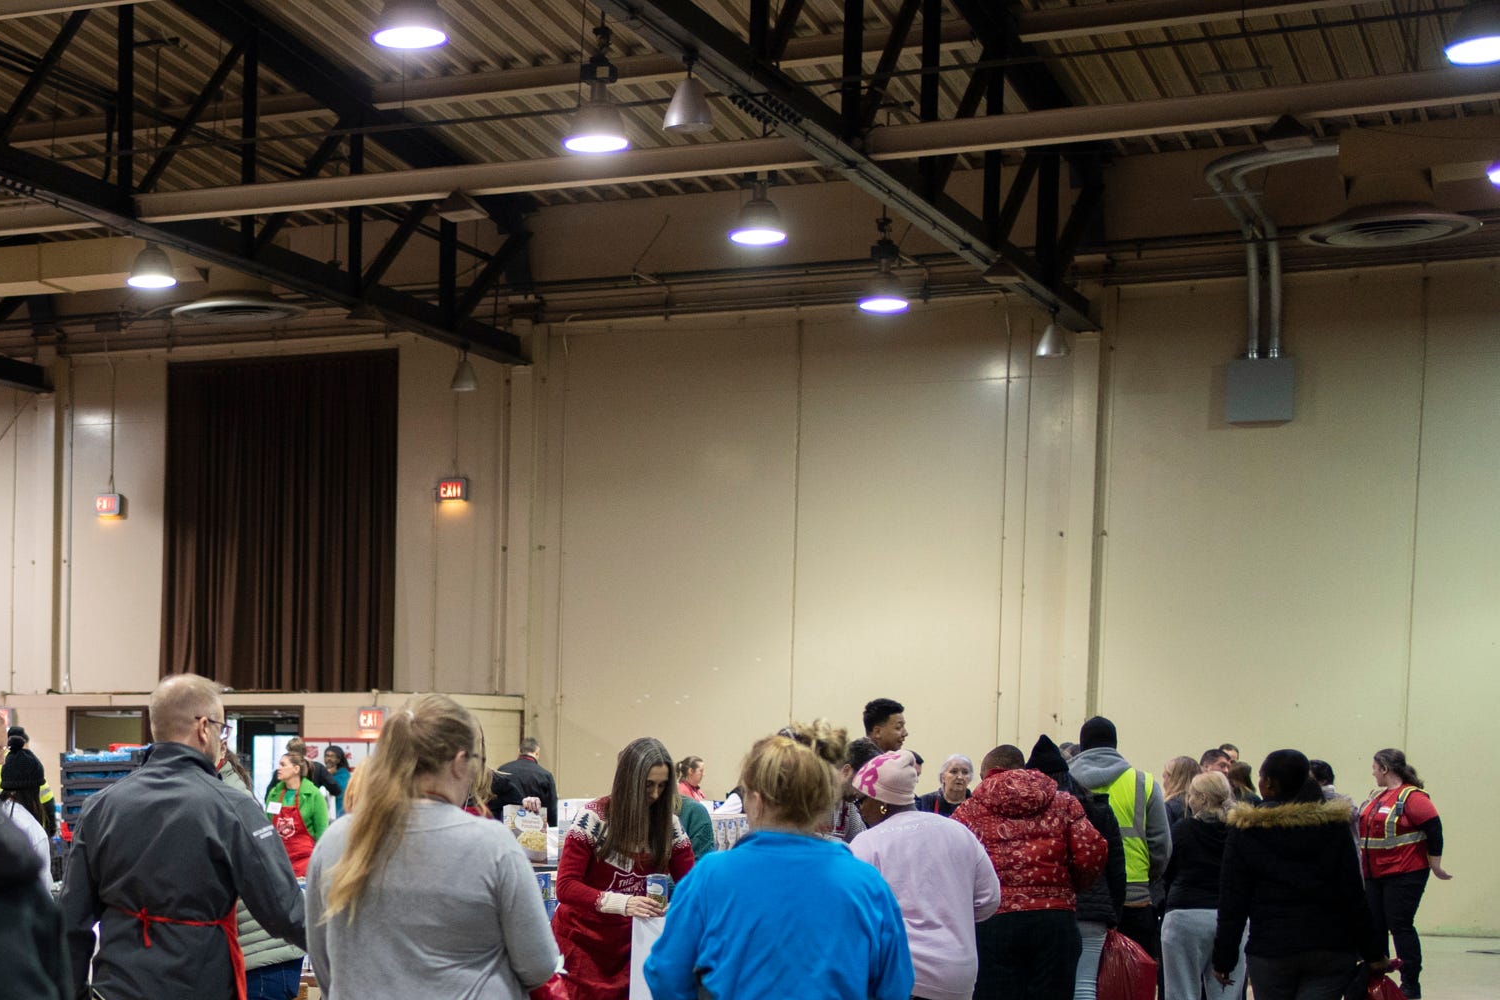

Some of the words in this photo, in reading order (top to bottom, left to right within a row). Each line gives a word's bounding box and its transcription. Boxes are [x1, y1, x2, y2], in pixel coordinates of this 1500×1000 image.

[440, 482, 463, 498] EXIT
[96, 496, 116, 512] EXIT
[360, 710, 383, 727] EXIT
[618, 877, 635, 889] THE
